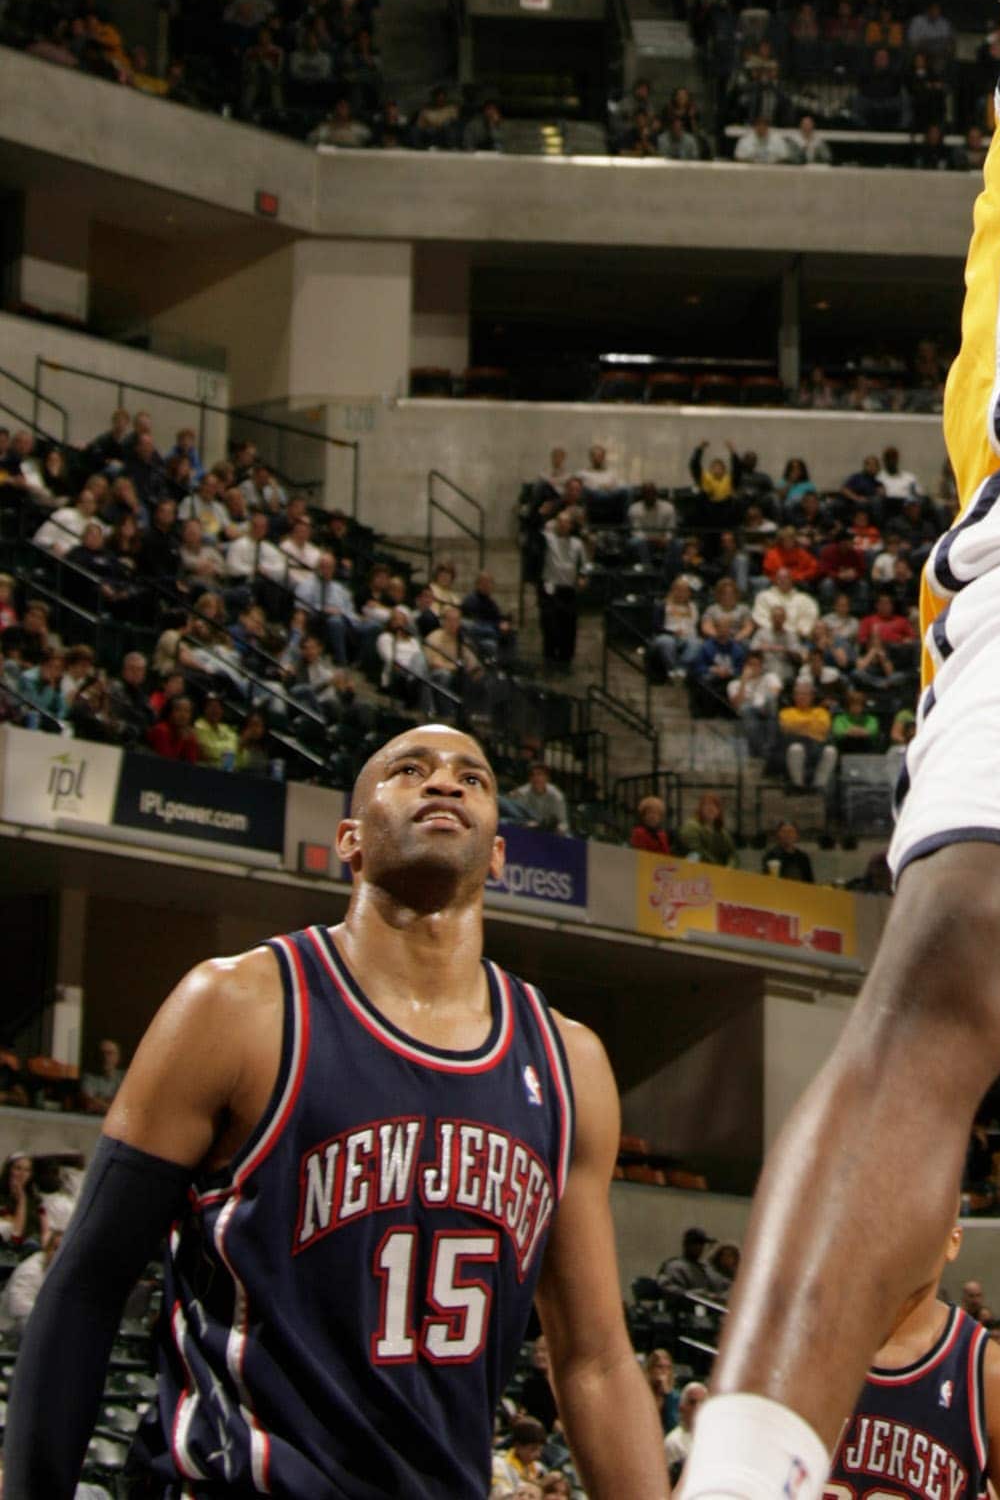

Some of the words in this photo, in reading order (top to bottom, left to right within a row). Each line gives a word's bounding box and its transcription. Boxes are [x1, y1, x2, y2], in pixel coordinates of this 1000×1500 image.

[47, 757, 87, 811] ipl
[485, 864, 573, 900] xpress
[293, 1116, 424, 1255] NEW
[419, 1118, 554, 1282] JERSEY
[370, 1225, 500, 1365] 15
[843, 1414, 967, 1500] JERSEY
